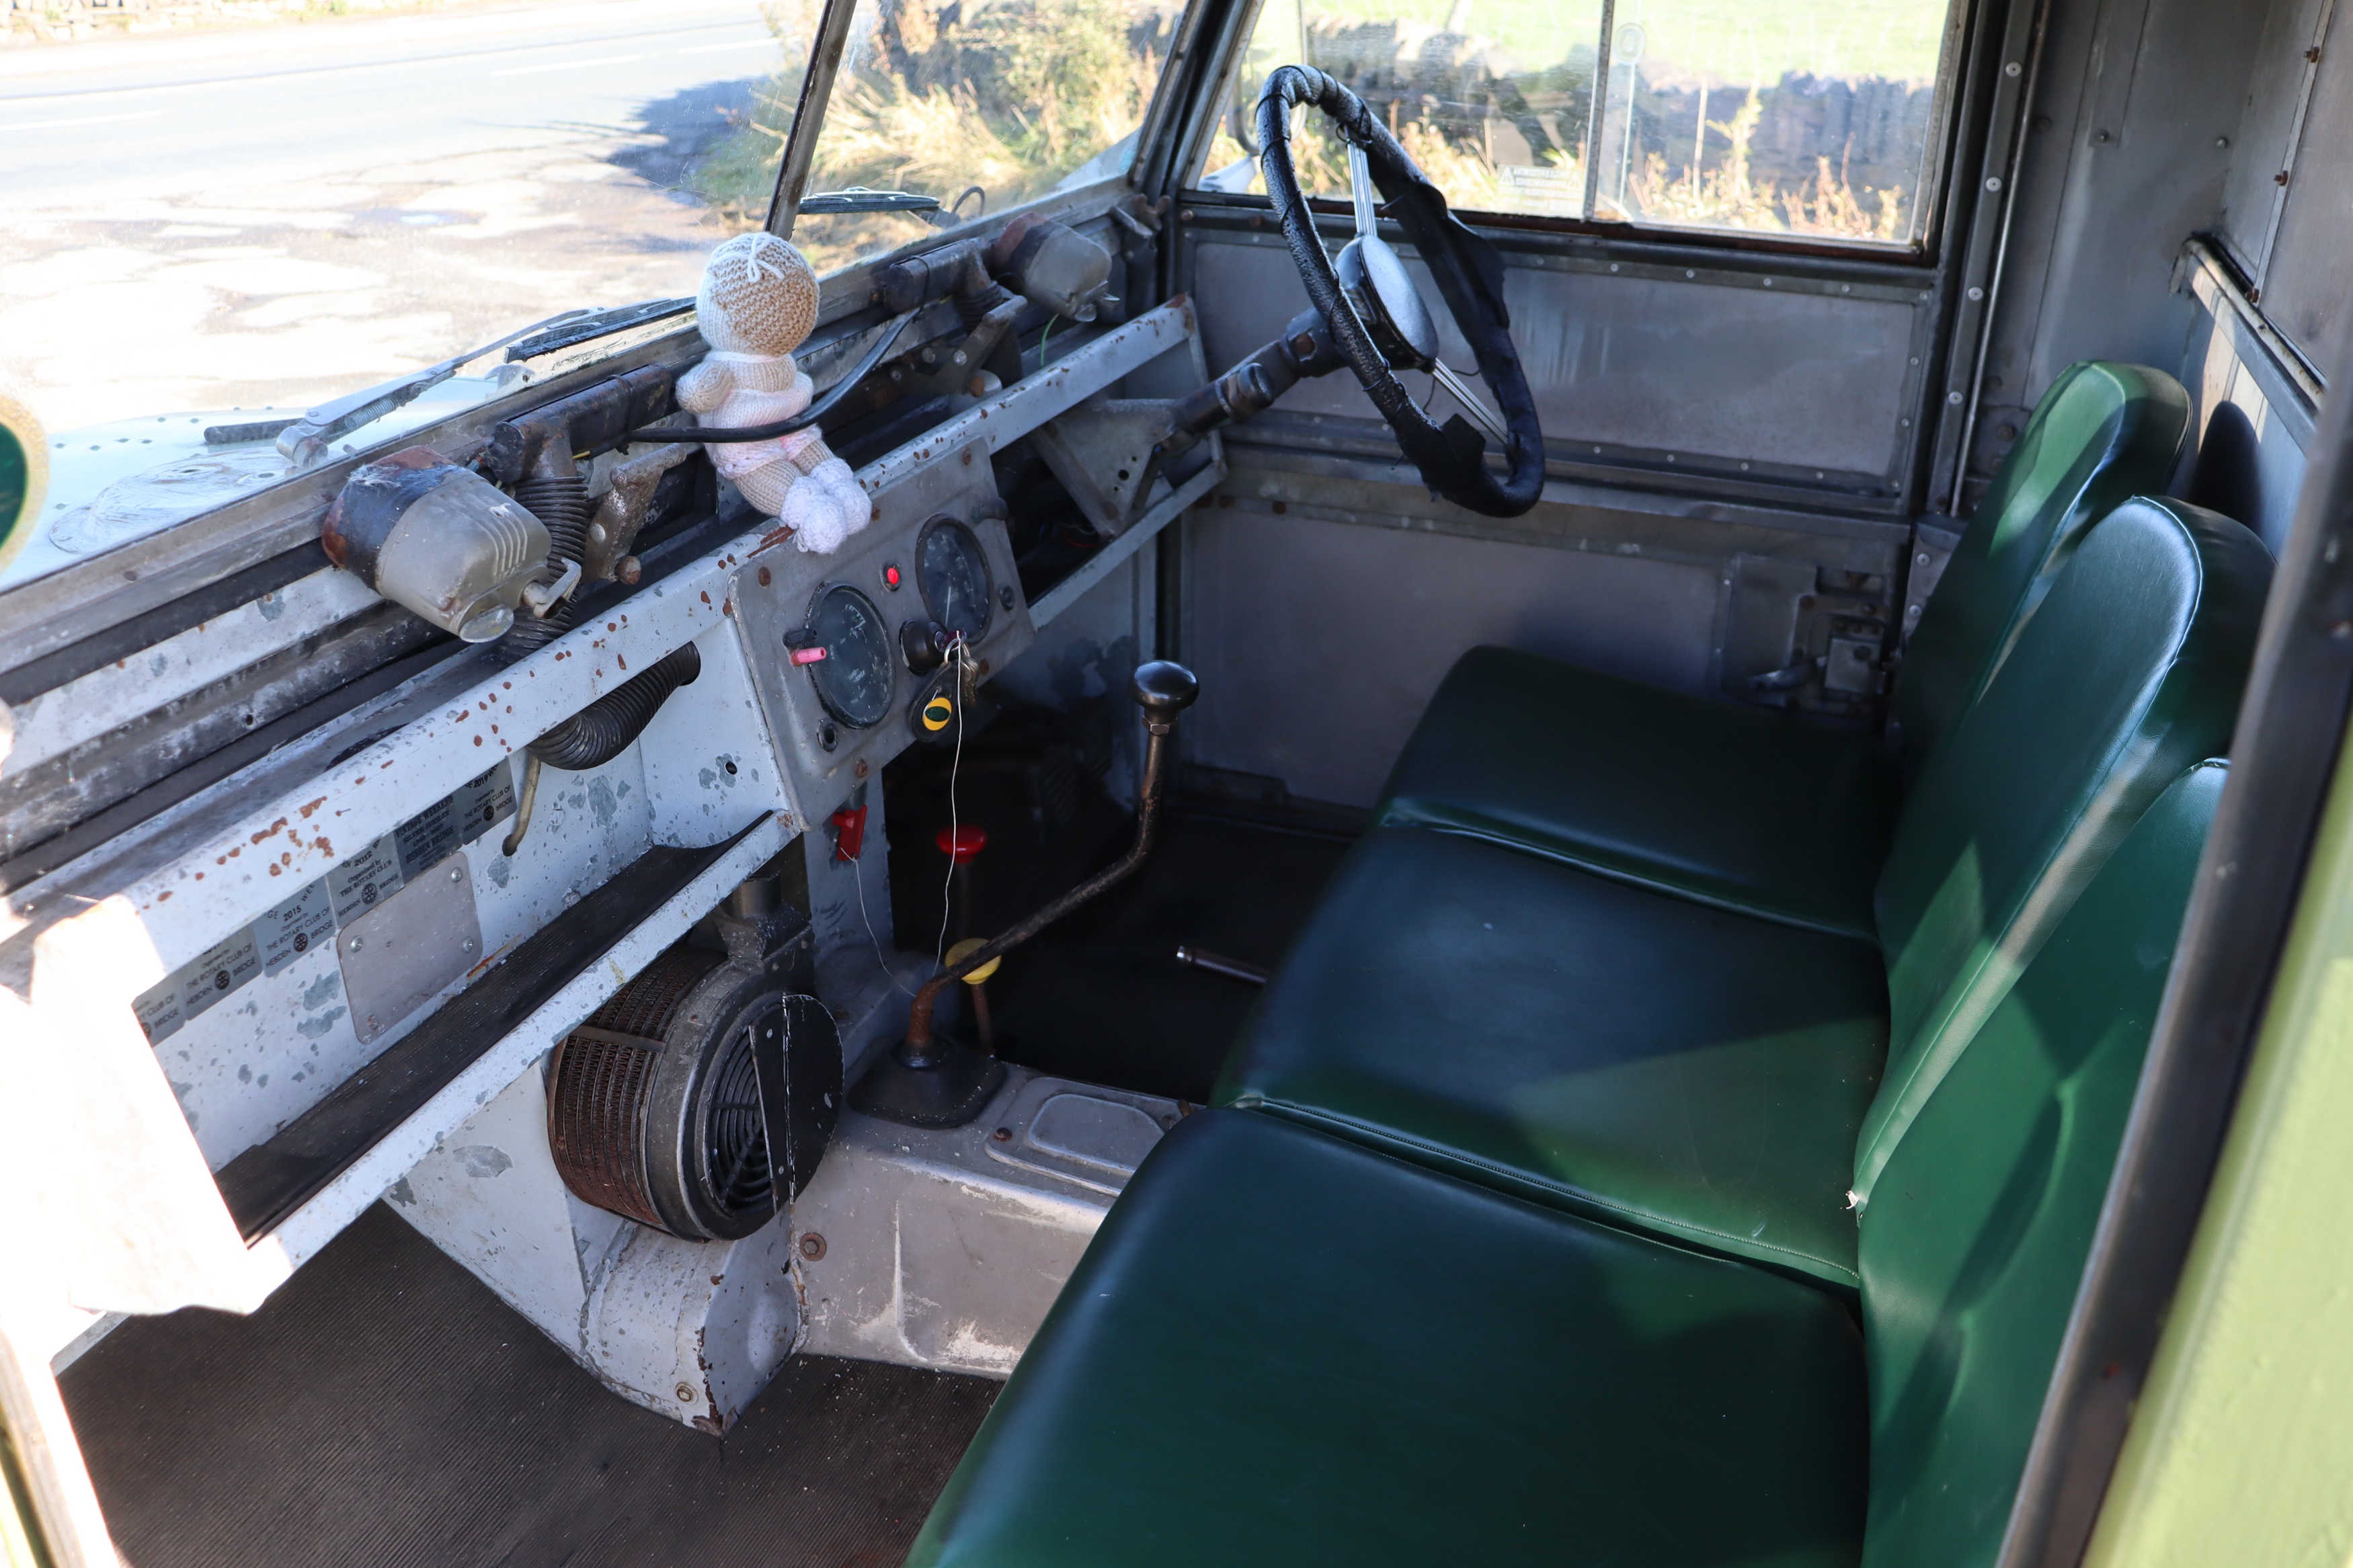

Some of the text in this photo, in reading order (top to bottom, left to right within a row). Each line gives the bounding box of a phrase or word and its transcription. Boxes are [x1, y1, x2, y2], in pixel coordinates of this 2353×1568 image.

[473, 774, 489, 788] 2019
[395, 794, 454, 837] VINTAGE WEEKEND
[463, 796, 513, 833] HEBDEN BRIDGE
[465, 784, 511, 819] THE ROTARY CLUB OF
[354, 850, 373, 867] 2012
[405, 841, 430, 865] HEBDEN
[431, 825, 454, 847] BRIDGE
[340, 860, 393, 897] THE ROTARY CLUB
[348, 861, 376, 884] Organised
[283, 905, 302, 921] 2015
[338, 872, 399, 917] HEBDEN BRIDGE
[266, 906, 331, 952] THE ROTARY CLUB OF
[281, 915, 303, 932] Organised
[266, 919, 334, 968] HEBDEN BRIDGE
[186, 942, 253, 989] THE ROTARY CLUB OF
[186, 956, 257, 1007] HEBDEN BRIDGE
[147, 1001, 165, 1016] CLUB
[165, 993, 175, 1004] OF
[154, 1007, 180, 1029] BRIDGE
